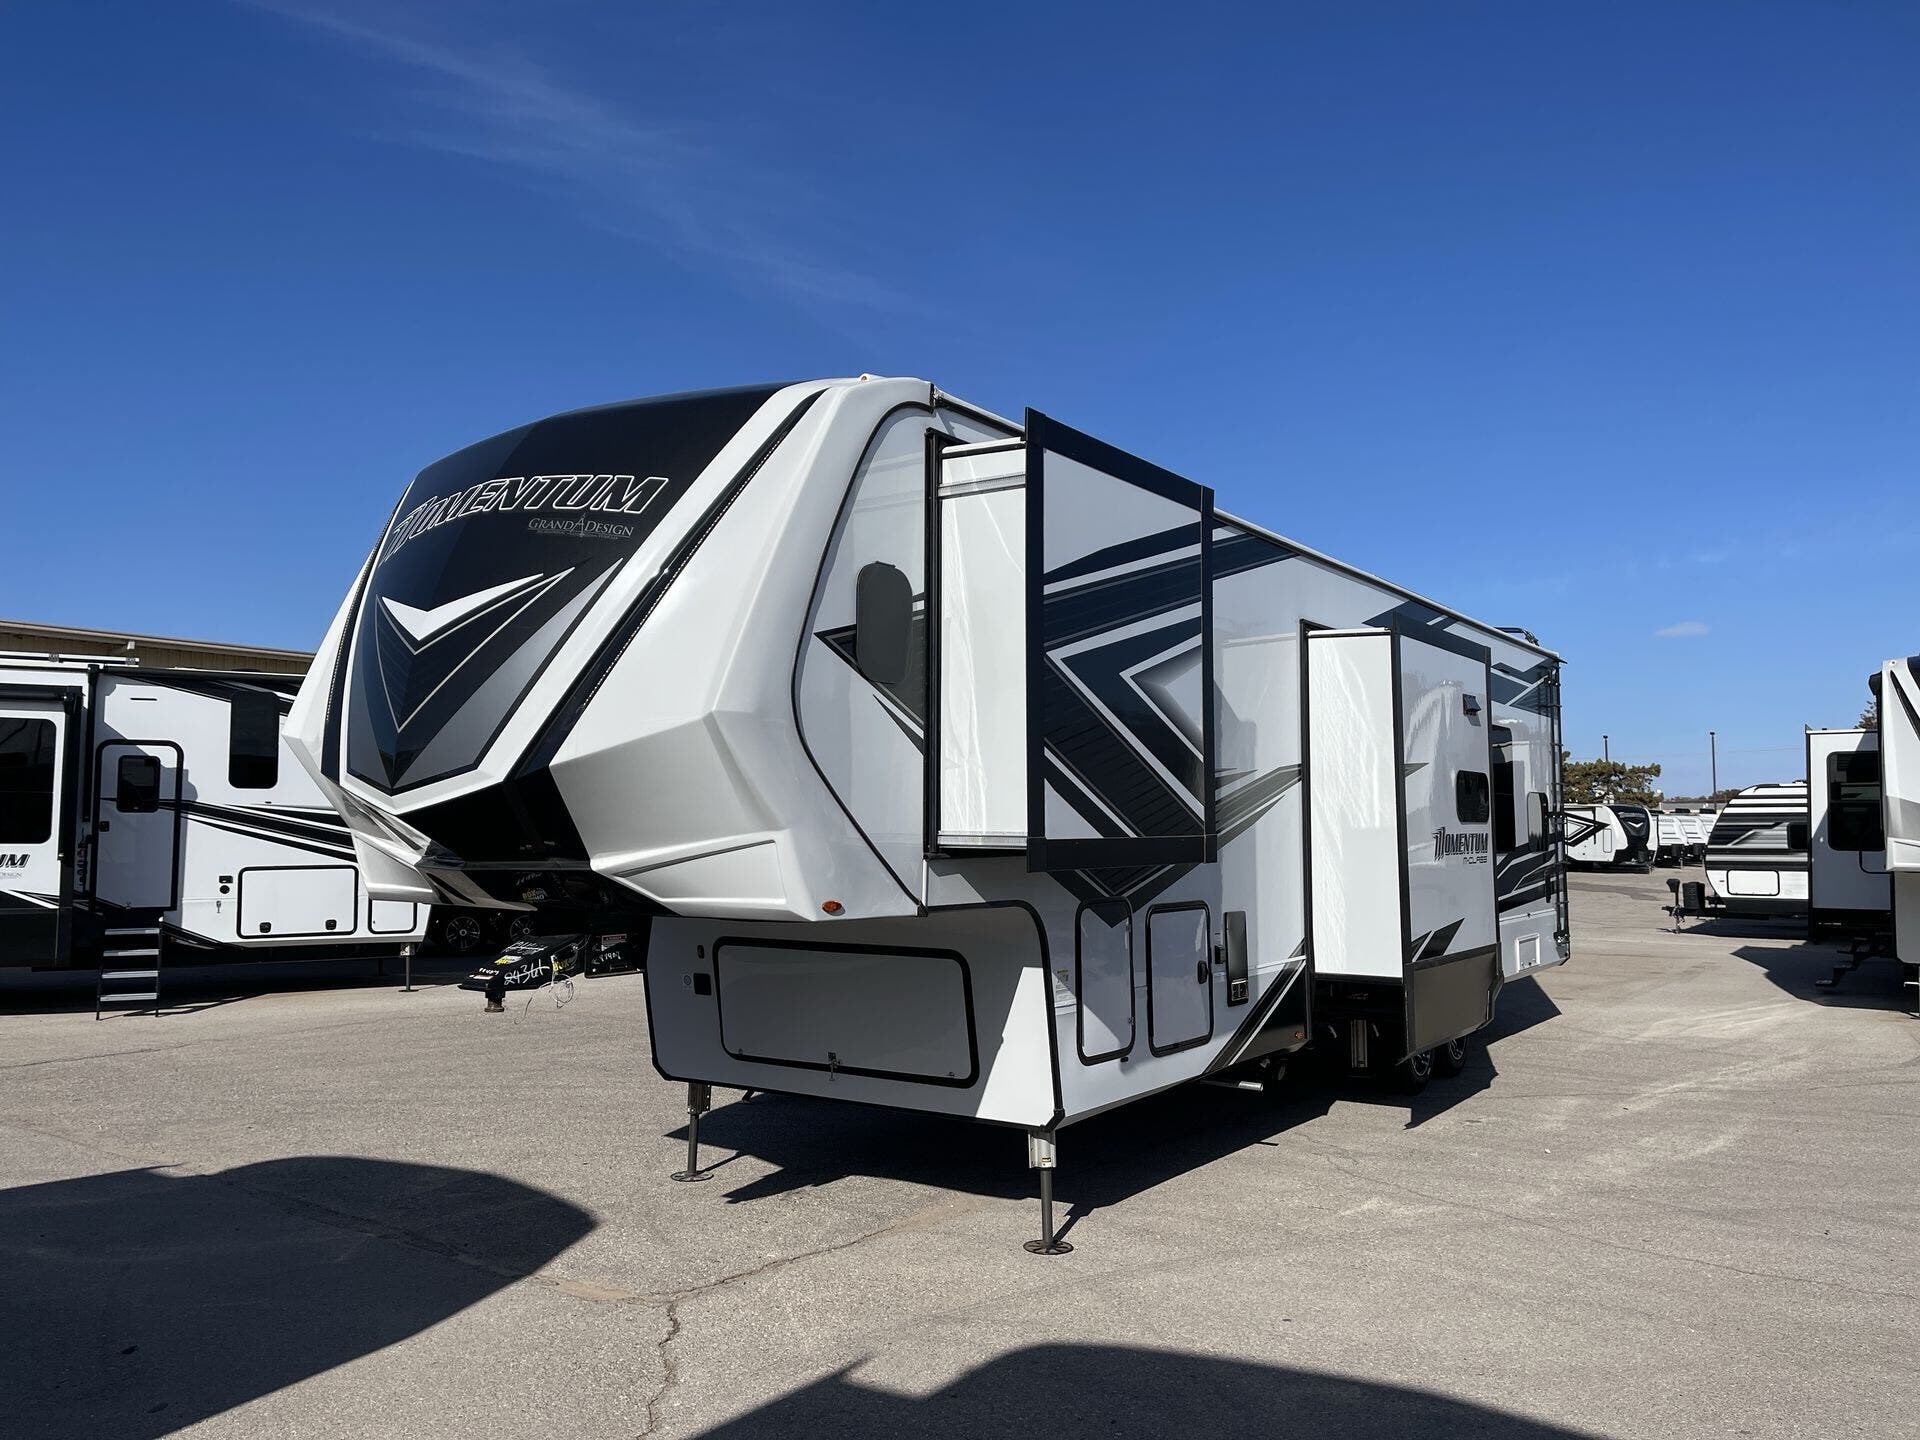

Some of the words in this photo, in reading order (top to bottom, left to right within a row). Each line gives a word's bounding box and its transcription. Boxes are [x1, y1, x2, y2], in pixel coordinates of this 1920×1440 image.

[378, 474, 669, 568] MOMENTUM
[528, 517, 575, 531] GRAND
[584, 520, 634, 537] DESIGN
[1431, 826, 1489, 861] MOMENTUM
